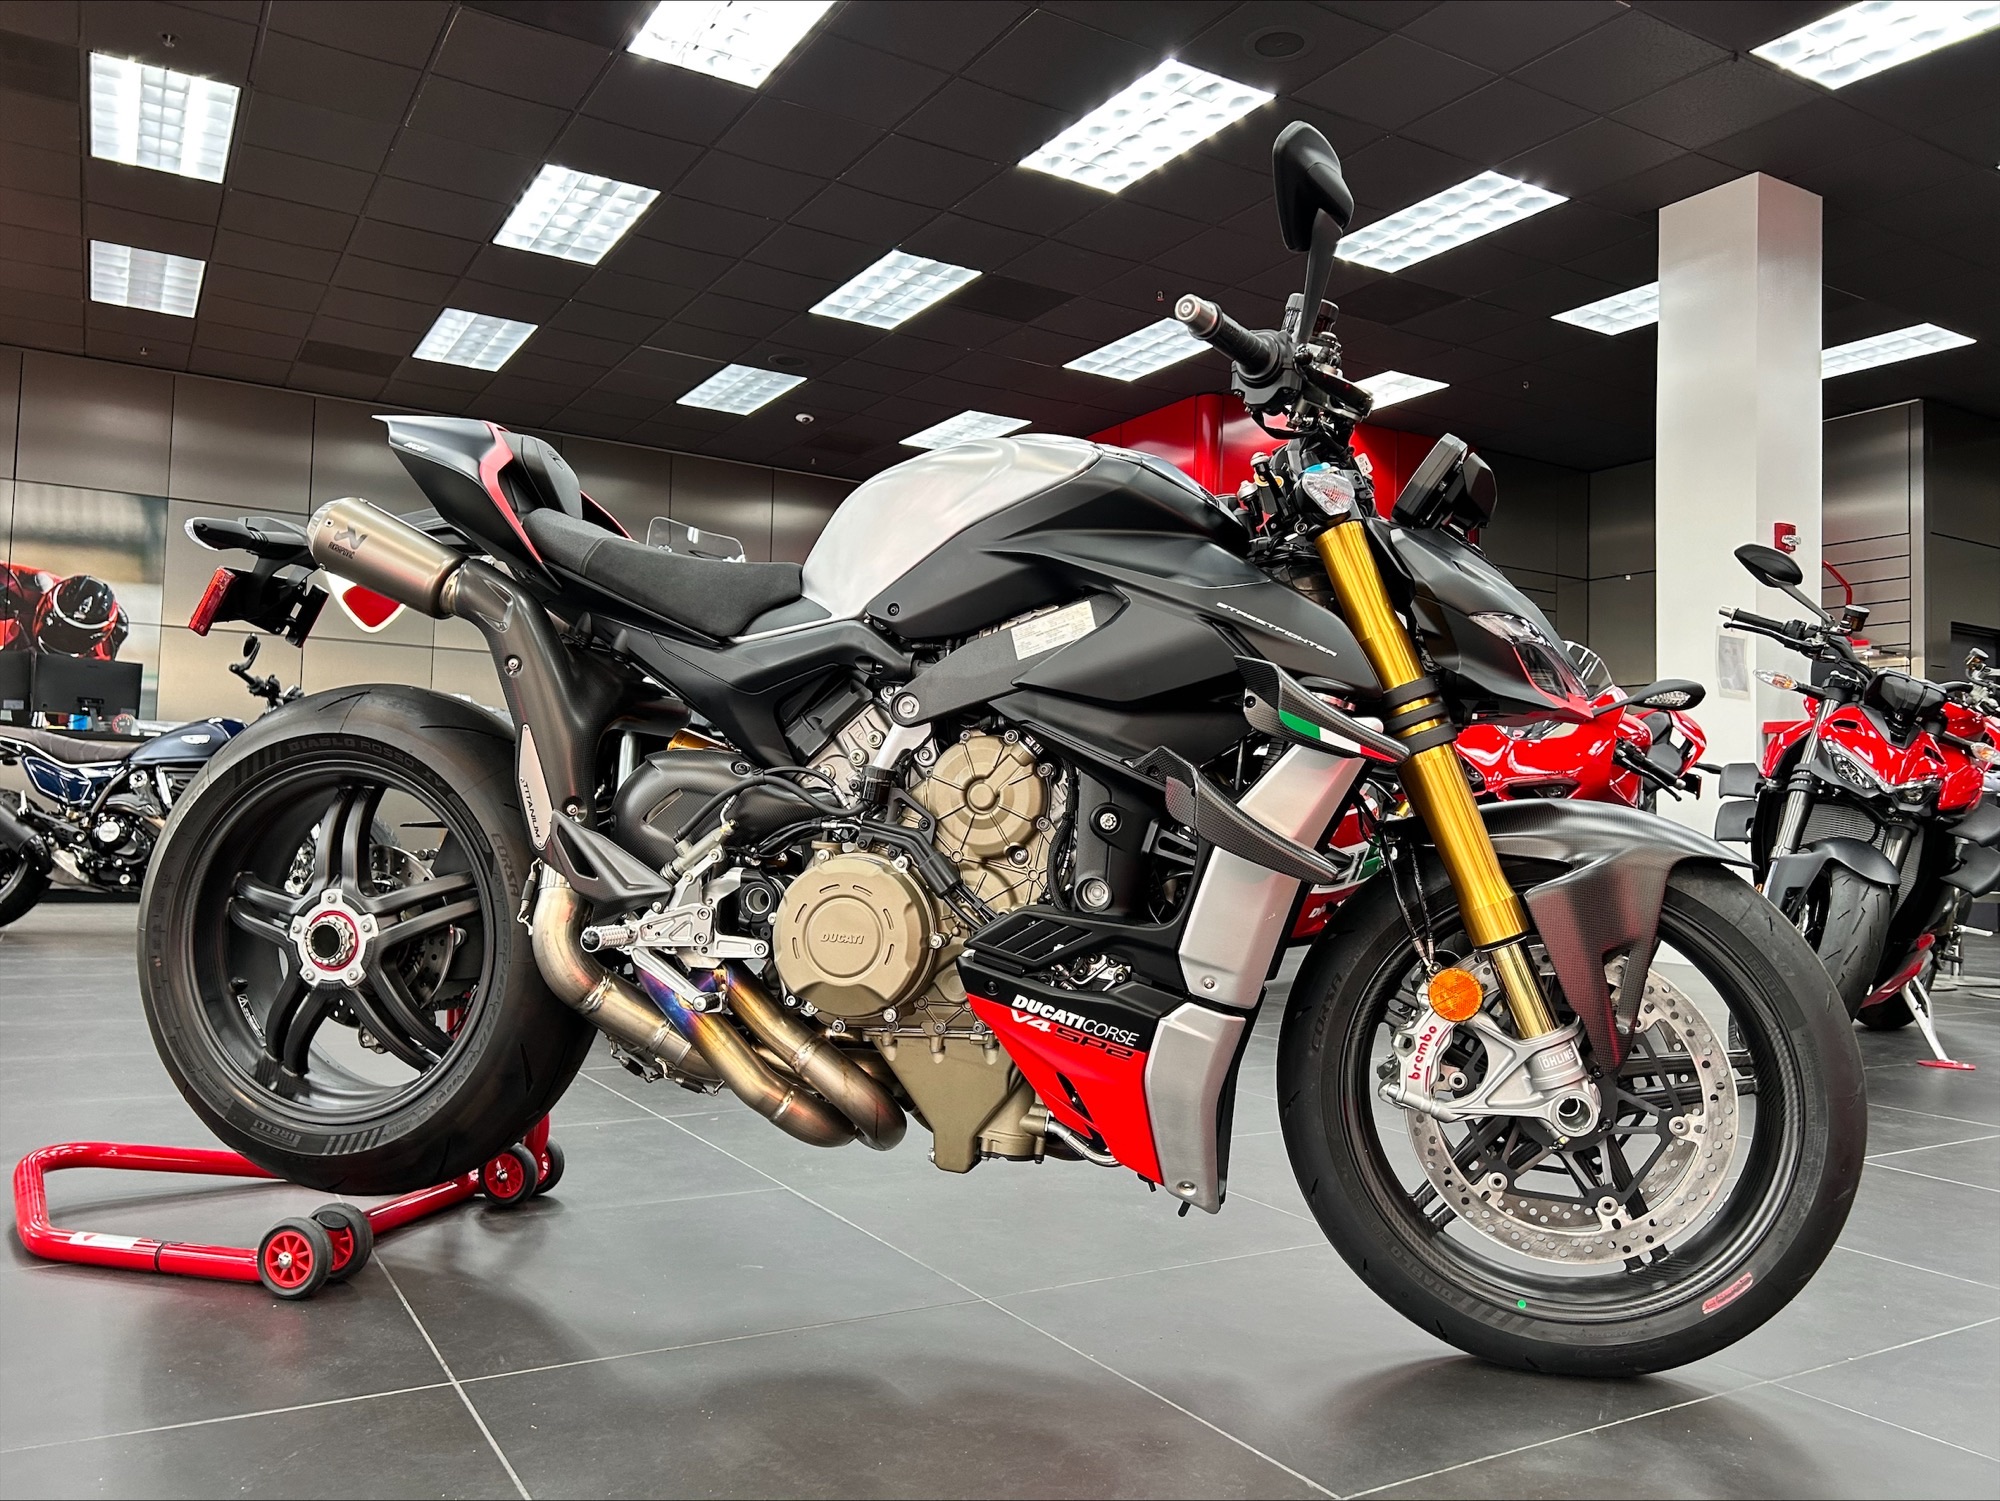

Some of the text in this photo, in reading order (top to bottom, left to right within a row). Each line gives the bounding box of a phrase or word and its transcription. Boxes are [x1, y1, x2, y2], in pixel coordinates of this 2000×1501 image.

[1216, 602, 1338, 657] STREETFIGHTER
[287, 737, 355, 752] DIABLO
[523, 783, 541, 838] TITANIUM
[491, 833, 520, 898] CORSA
[820, 933, 865, 945] DUCATI
[1010, 1008, 1135, 1060] V4 SP2
[1408, 1025, 1438, 1081] brembo
[250, 1119, 302, 1148] PIRELLI
